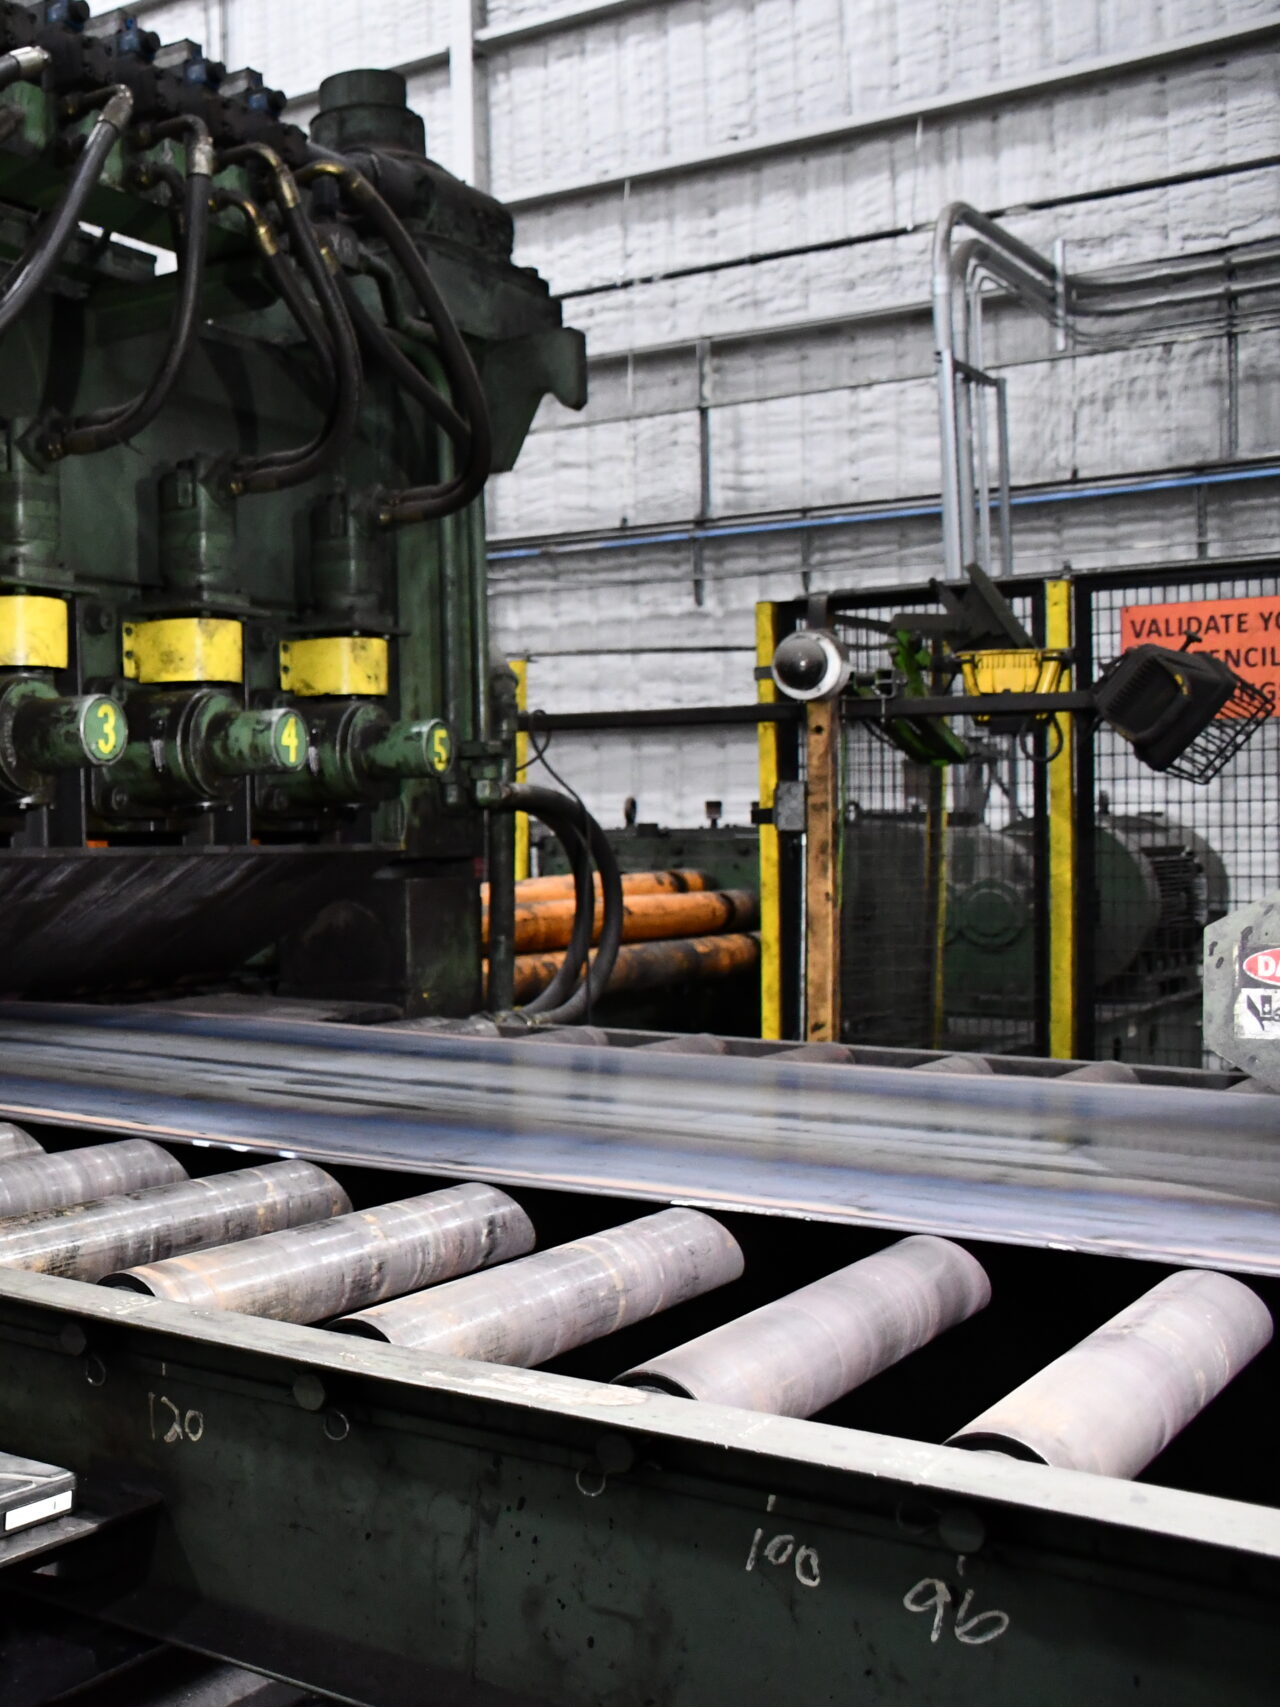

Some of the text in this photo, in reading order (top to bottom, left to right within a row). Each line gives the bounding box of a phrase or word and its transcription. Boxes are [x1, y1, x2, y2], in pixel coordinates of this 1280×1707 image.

[1130, 611, 1280, 639] VALIDATE Y
[97, 704, 116, 754] 3
[281, 716, 298, 763] 4
[433, 729, 448, 771] 5
[1257, 955, 1280, 977] D
[148, 1391, 204, 1442] 120
[745, 1527, 820, 1587] 100
[902, 1577, 1010, 1644] 96
